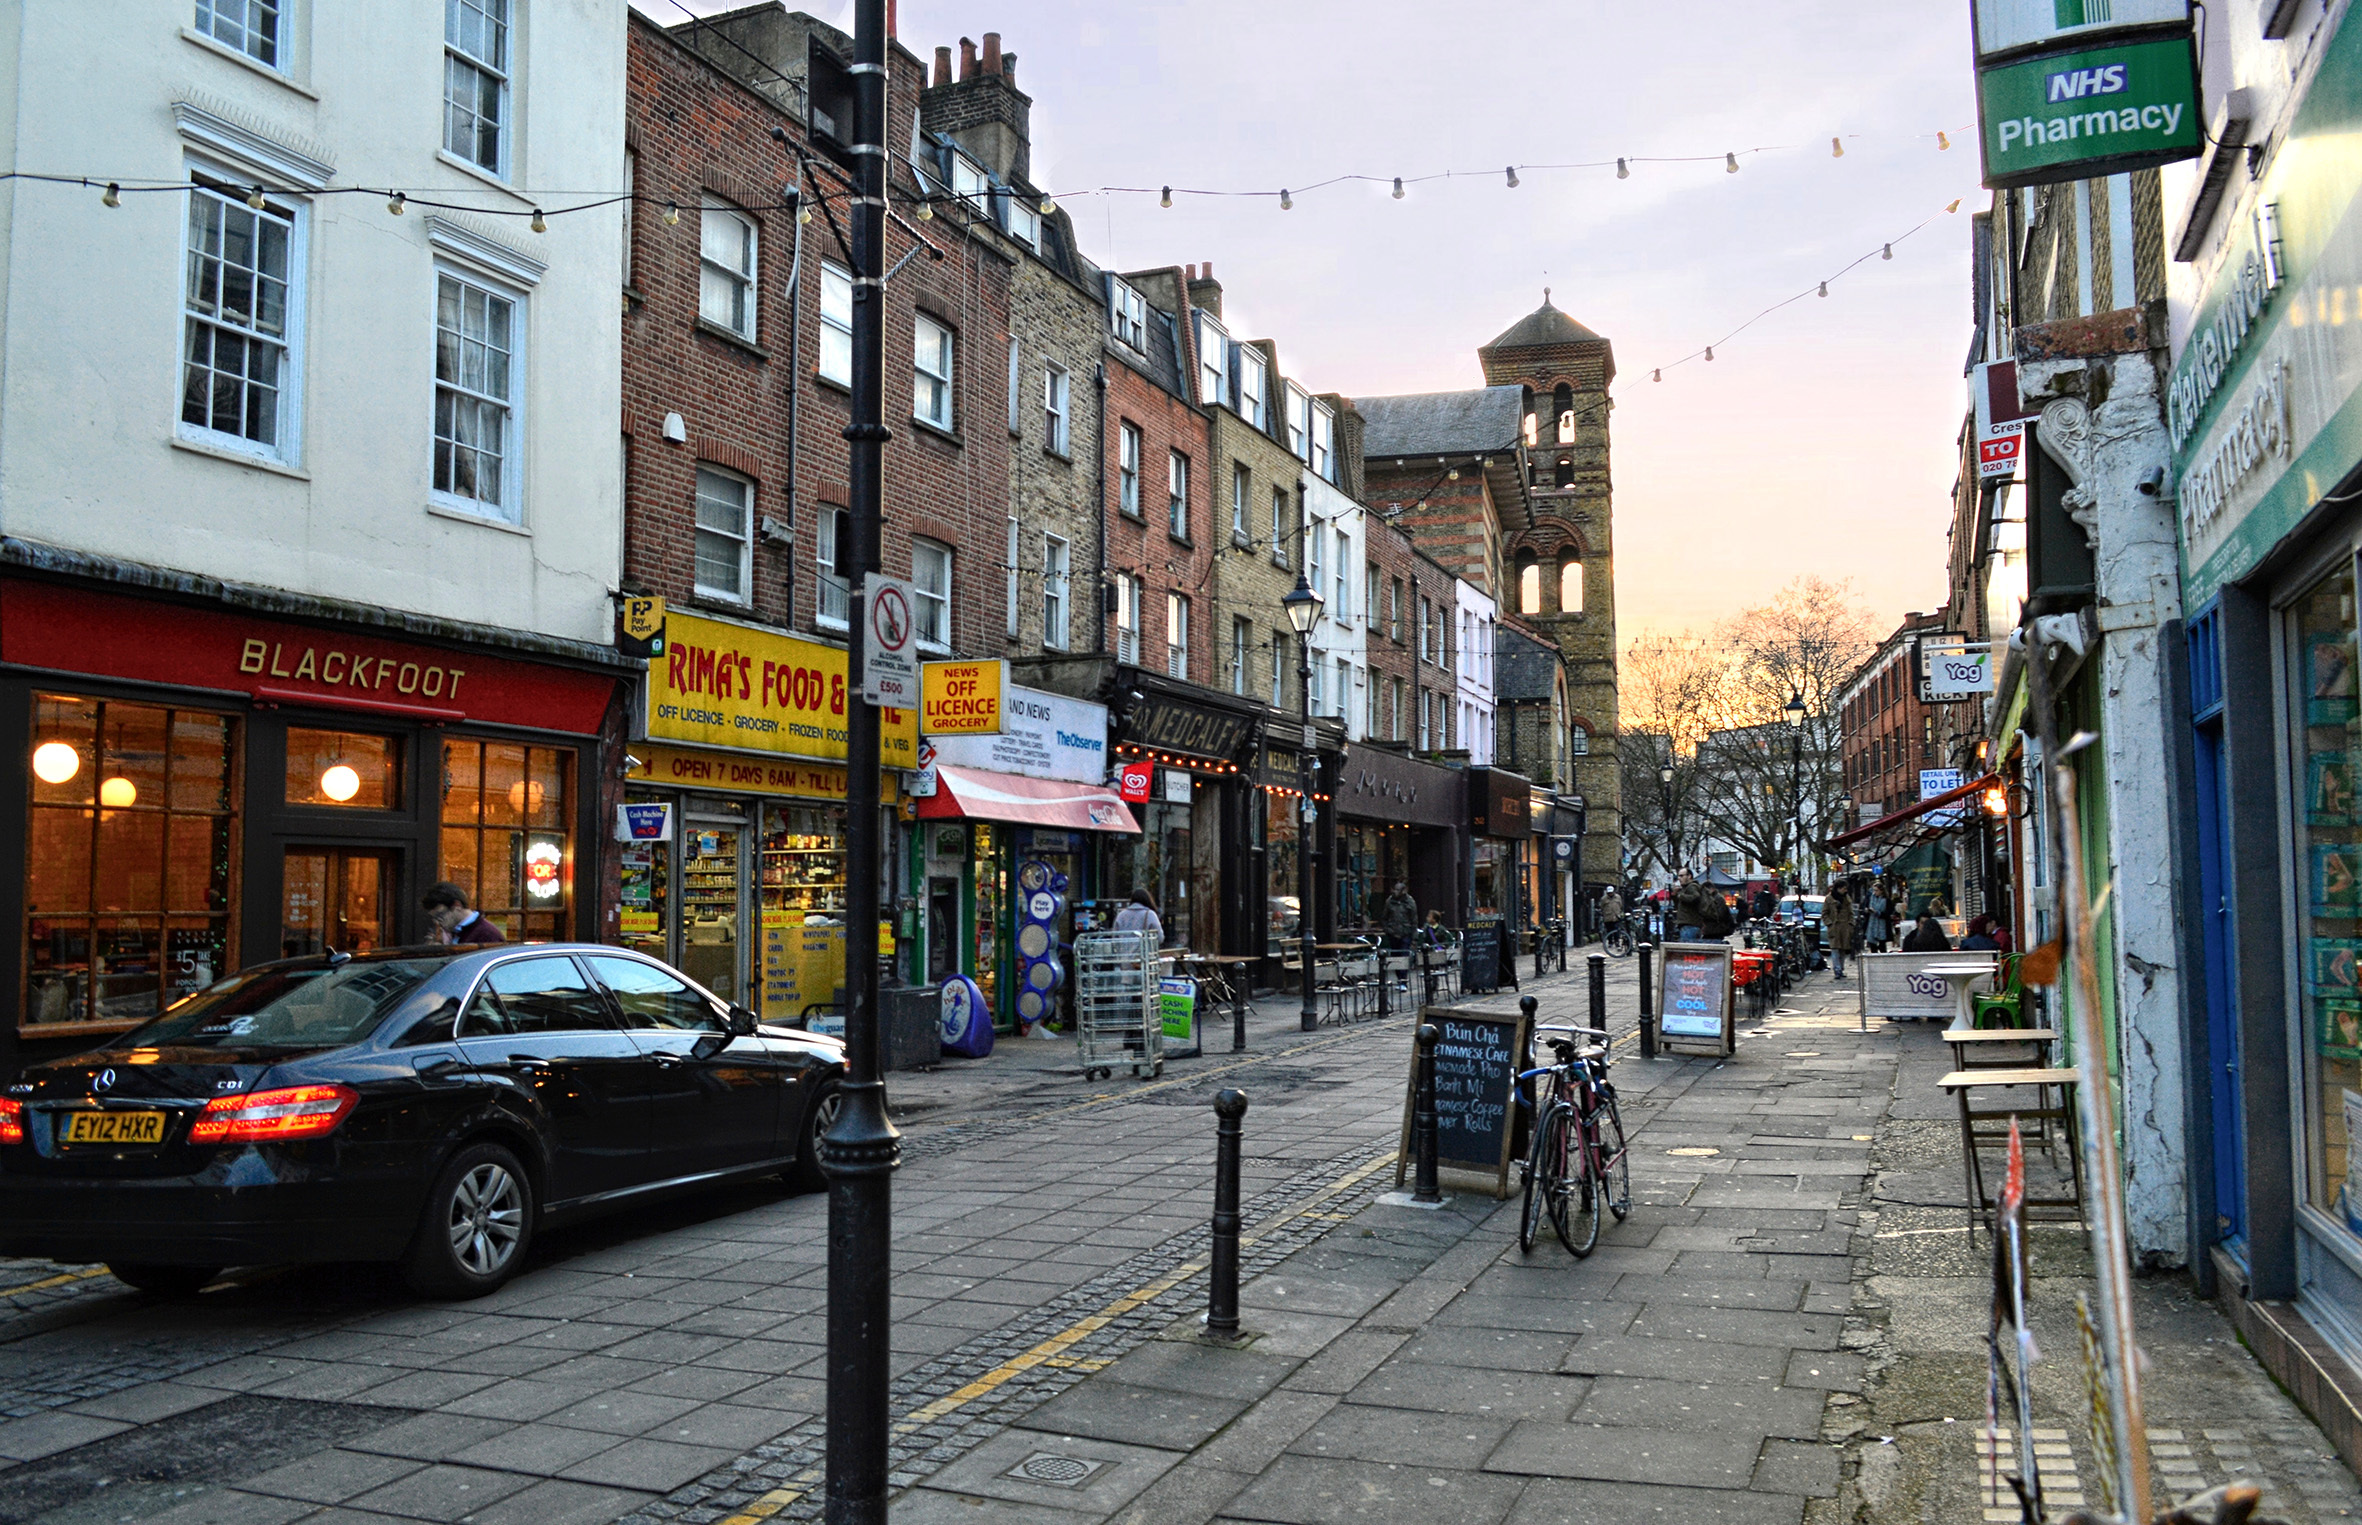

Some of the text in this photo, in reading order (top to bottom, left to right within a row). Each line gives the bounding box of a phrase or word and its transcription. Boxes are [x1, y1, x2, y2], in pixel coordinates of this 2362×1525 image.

[2050, 65, 2124, 101] NHS
[1998, 103, 2183, 152] Pharmacy
[2167, 192, 2282, 454] Clerkenwell
[1991, 423, 2022, 435] Cres
[1985, 441, 2015, 457] TO
[2179, 357, 2287, 548] Pharmacy
[1982, 462, 2002, 473] 020
[632, 617, 645, 625] Pay
[631, 624, 652, 633] Point
[879, 652, 903, 662] ALCOHOL
[240, 638, 465, 700] BLACKFOOT
[870, 659, 912, 672] CONTROL ZONE
[669, 642, 845, 715] RIMA'S FOOD &
[944, 668, 979, 678] NEWS
[1945, 663, 1981, 683] Yog
[880, 681, 903, 694] £500
[946, 680, 977, 697] OFF
[927, 698, 996, 716] LICENCE
[1026, 703, 1051, 721] NEWS
[657, 704, 678, 720] OFF
[680, 707, 724, 726] LICENCE
[734, 715, 779, 734] GROCERY
[789, 723, 823, 739] FROZEN
[884, 737, 891, 748] &
[893, 738, 909, 751] VEG
[932, 717, 989, 728] GROCERY
[1150, 705, 1234, 751] MEDCALF
[1056, 730, 1102, 752] TheObserver
[672, 758, 711, 780] OPEN
[717, 763, 725, 780] 7
[731, 765, 762, 785] DAYS
[769, 771, 796, 788] 6AM
[808, 773, 831, 792] TILL
[1922, 779, 1962, 789] TO LET
[1124, 788, 1145, 796] WALL'S
[629, 811, 641, 819] Cash
[640, 818, 653, 826] Here
[1034, 905, 1050, 913] here
[1467, 921, 1497, 929] MEDCALF
[1683, 956, 1706, 964] HOT
[1682, 971, 1706, 979] HOT
[1682, 986, 1705, 995] HOT
[1906, 974, 1947, 999] Yog
[1162, 1000, 1183, 1008] CASH
[1676, 1000, 1708, 1010] COOL
[1162, 1008, 1189, 1018] ACHINE
[812, 1024, 845, 1034] theguar
[1434, 1043, 1484, 1060] ETNAMESE
[1481, 1061, 1501, 1078] Pho
[217, 1080, 243, 1089] CDI
[1434, 1075, 1462, 1095] Banh
[1434, 1098, 1504, 1119] namese Coffee
[74, 1117, 158, 1140] EY12 HXR
[1464, 1113, 1493, 1133] Rolls
